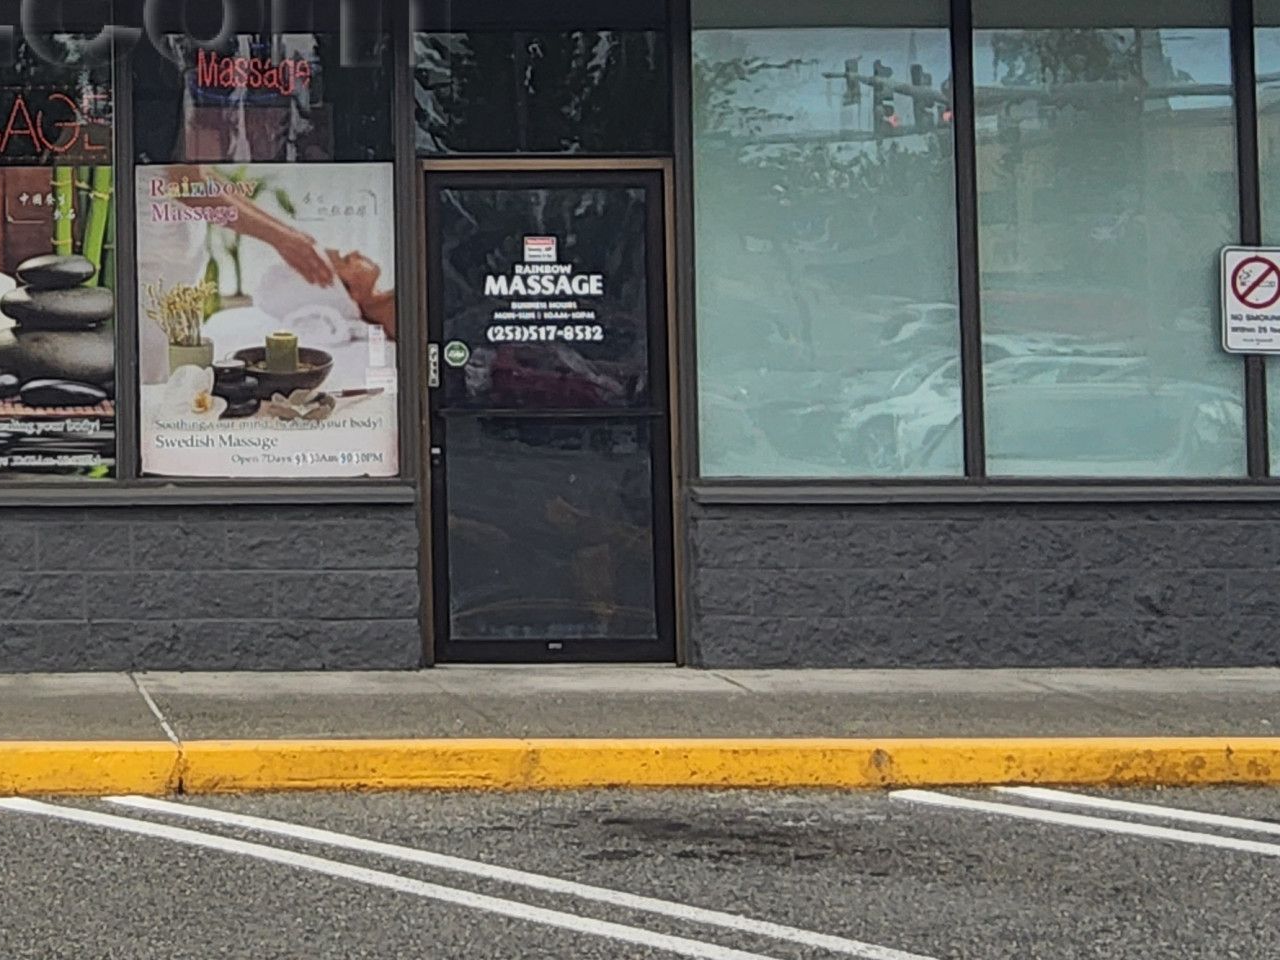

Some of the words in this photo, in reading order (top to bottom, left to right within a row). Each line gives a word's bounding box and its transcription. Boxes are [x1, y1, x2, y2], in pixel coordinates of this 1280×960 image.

[197, 47, 311, 96] Massage
[150, 177, 257, 199] Rainbow
[150, 203, 239, 226] Massage
[515, 264, 572, 274] RAINBOW
[484, 275, 604, 296] MASSAGE
[487, 325, 604, 342] (253)517-8532
[155, 434, 215, 448] Swedish
[219, 434, 279, 450] Massage
[231, 454, 259, 465] Open
